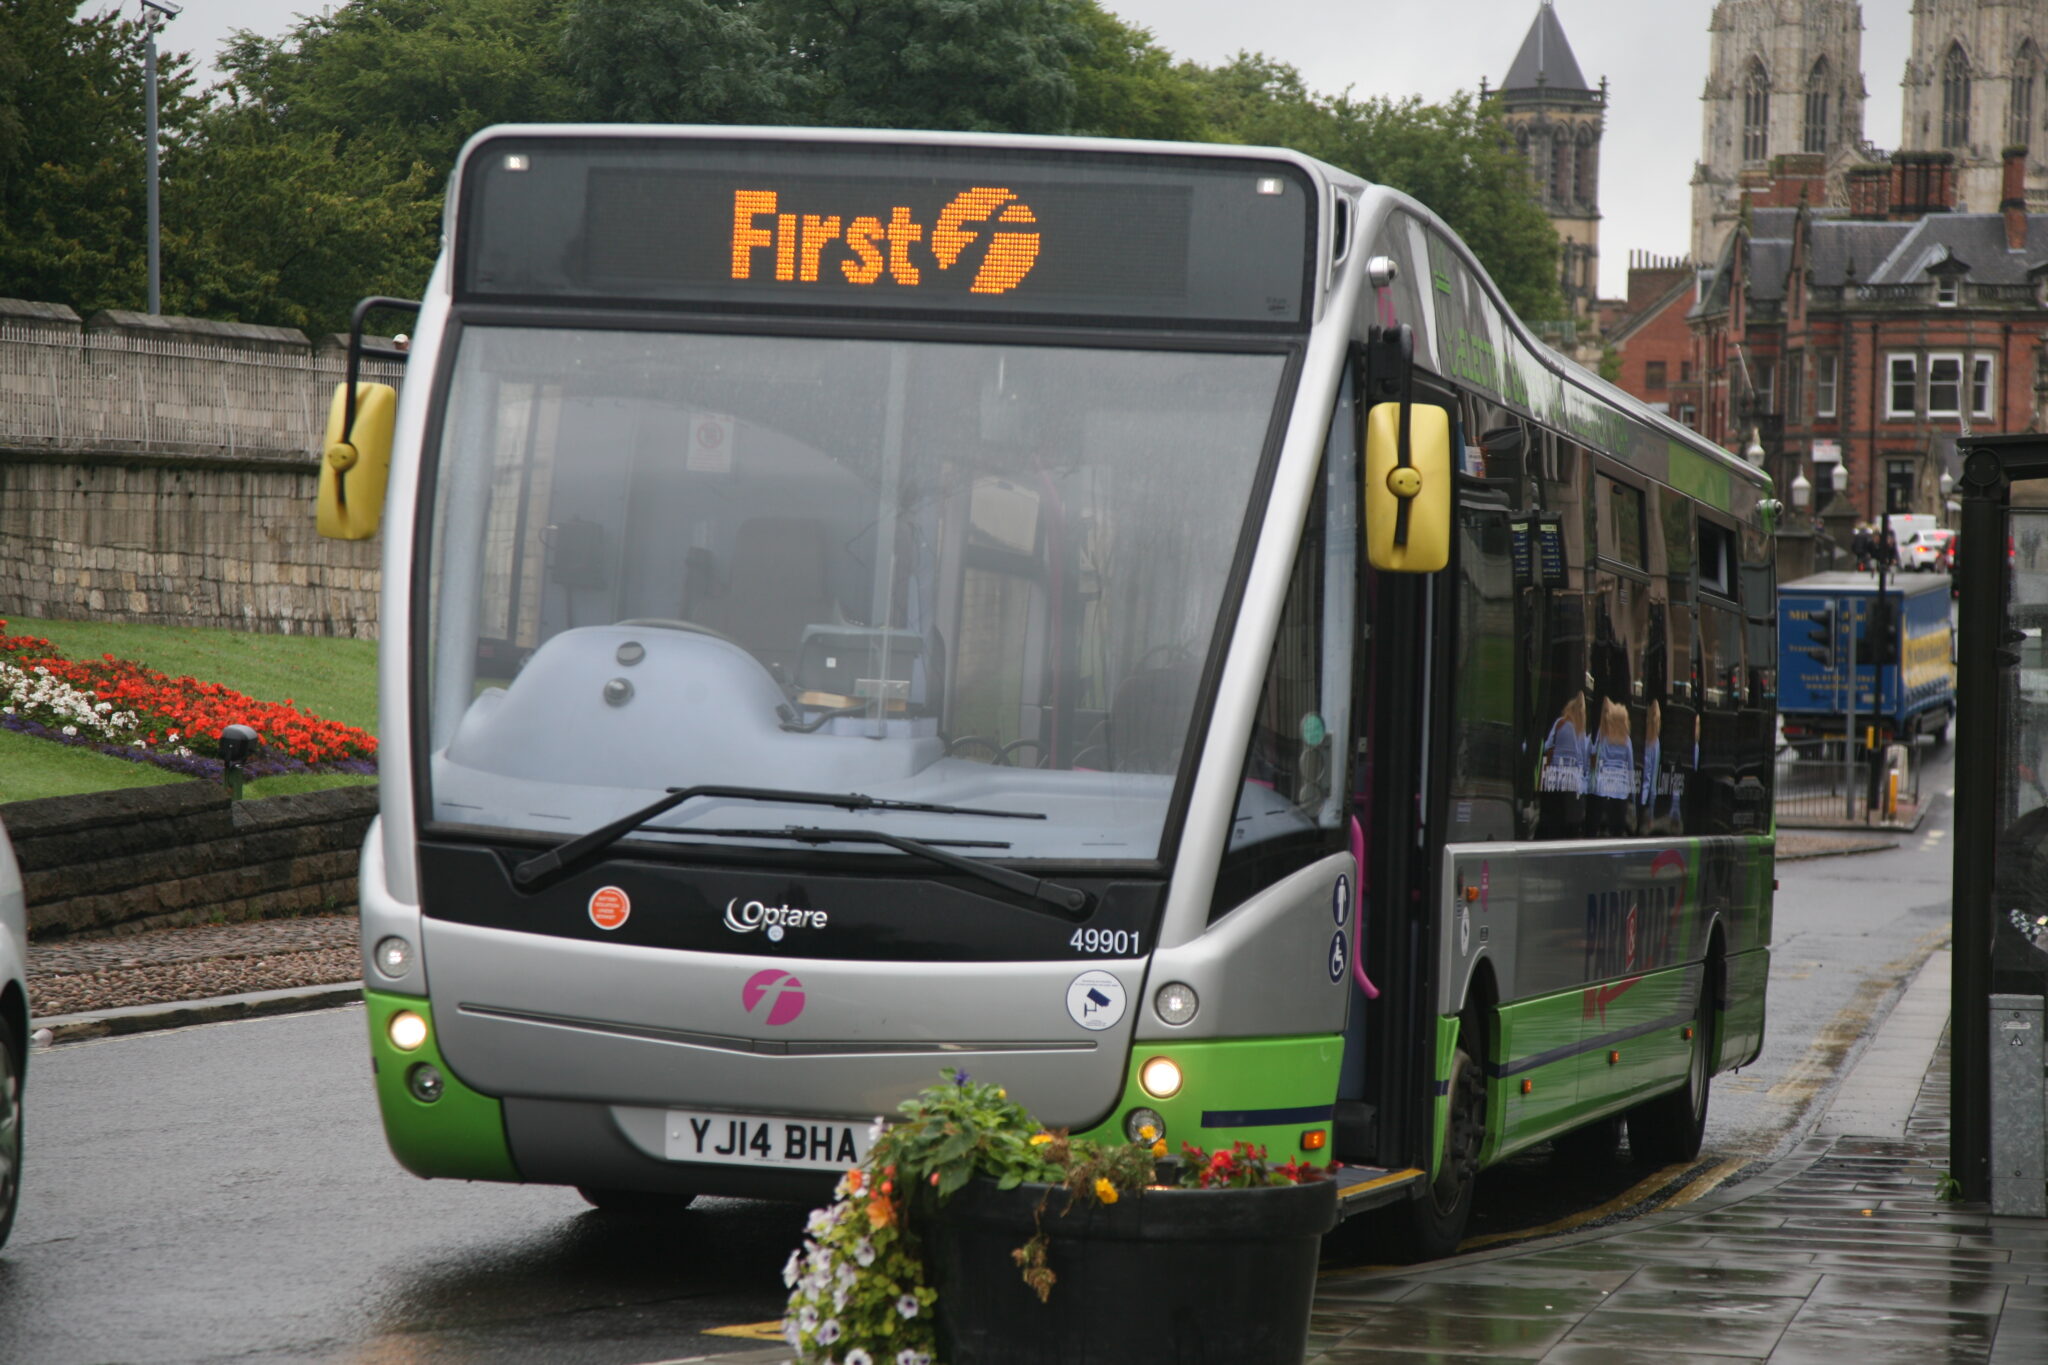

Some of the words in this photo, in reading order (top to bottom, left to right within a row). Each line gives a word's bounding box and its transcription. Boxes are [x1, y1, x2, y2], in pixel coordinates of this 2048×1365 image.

[731, 190, 922, 285] First
[741, 900, 829, 931] Optare
[1069, 927, 1140, 955] 49901
[690, 1118, 771, 1158] YJ14
[784, 1124, 858, 1164] BHA
